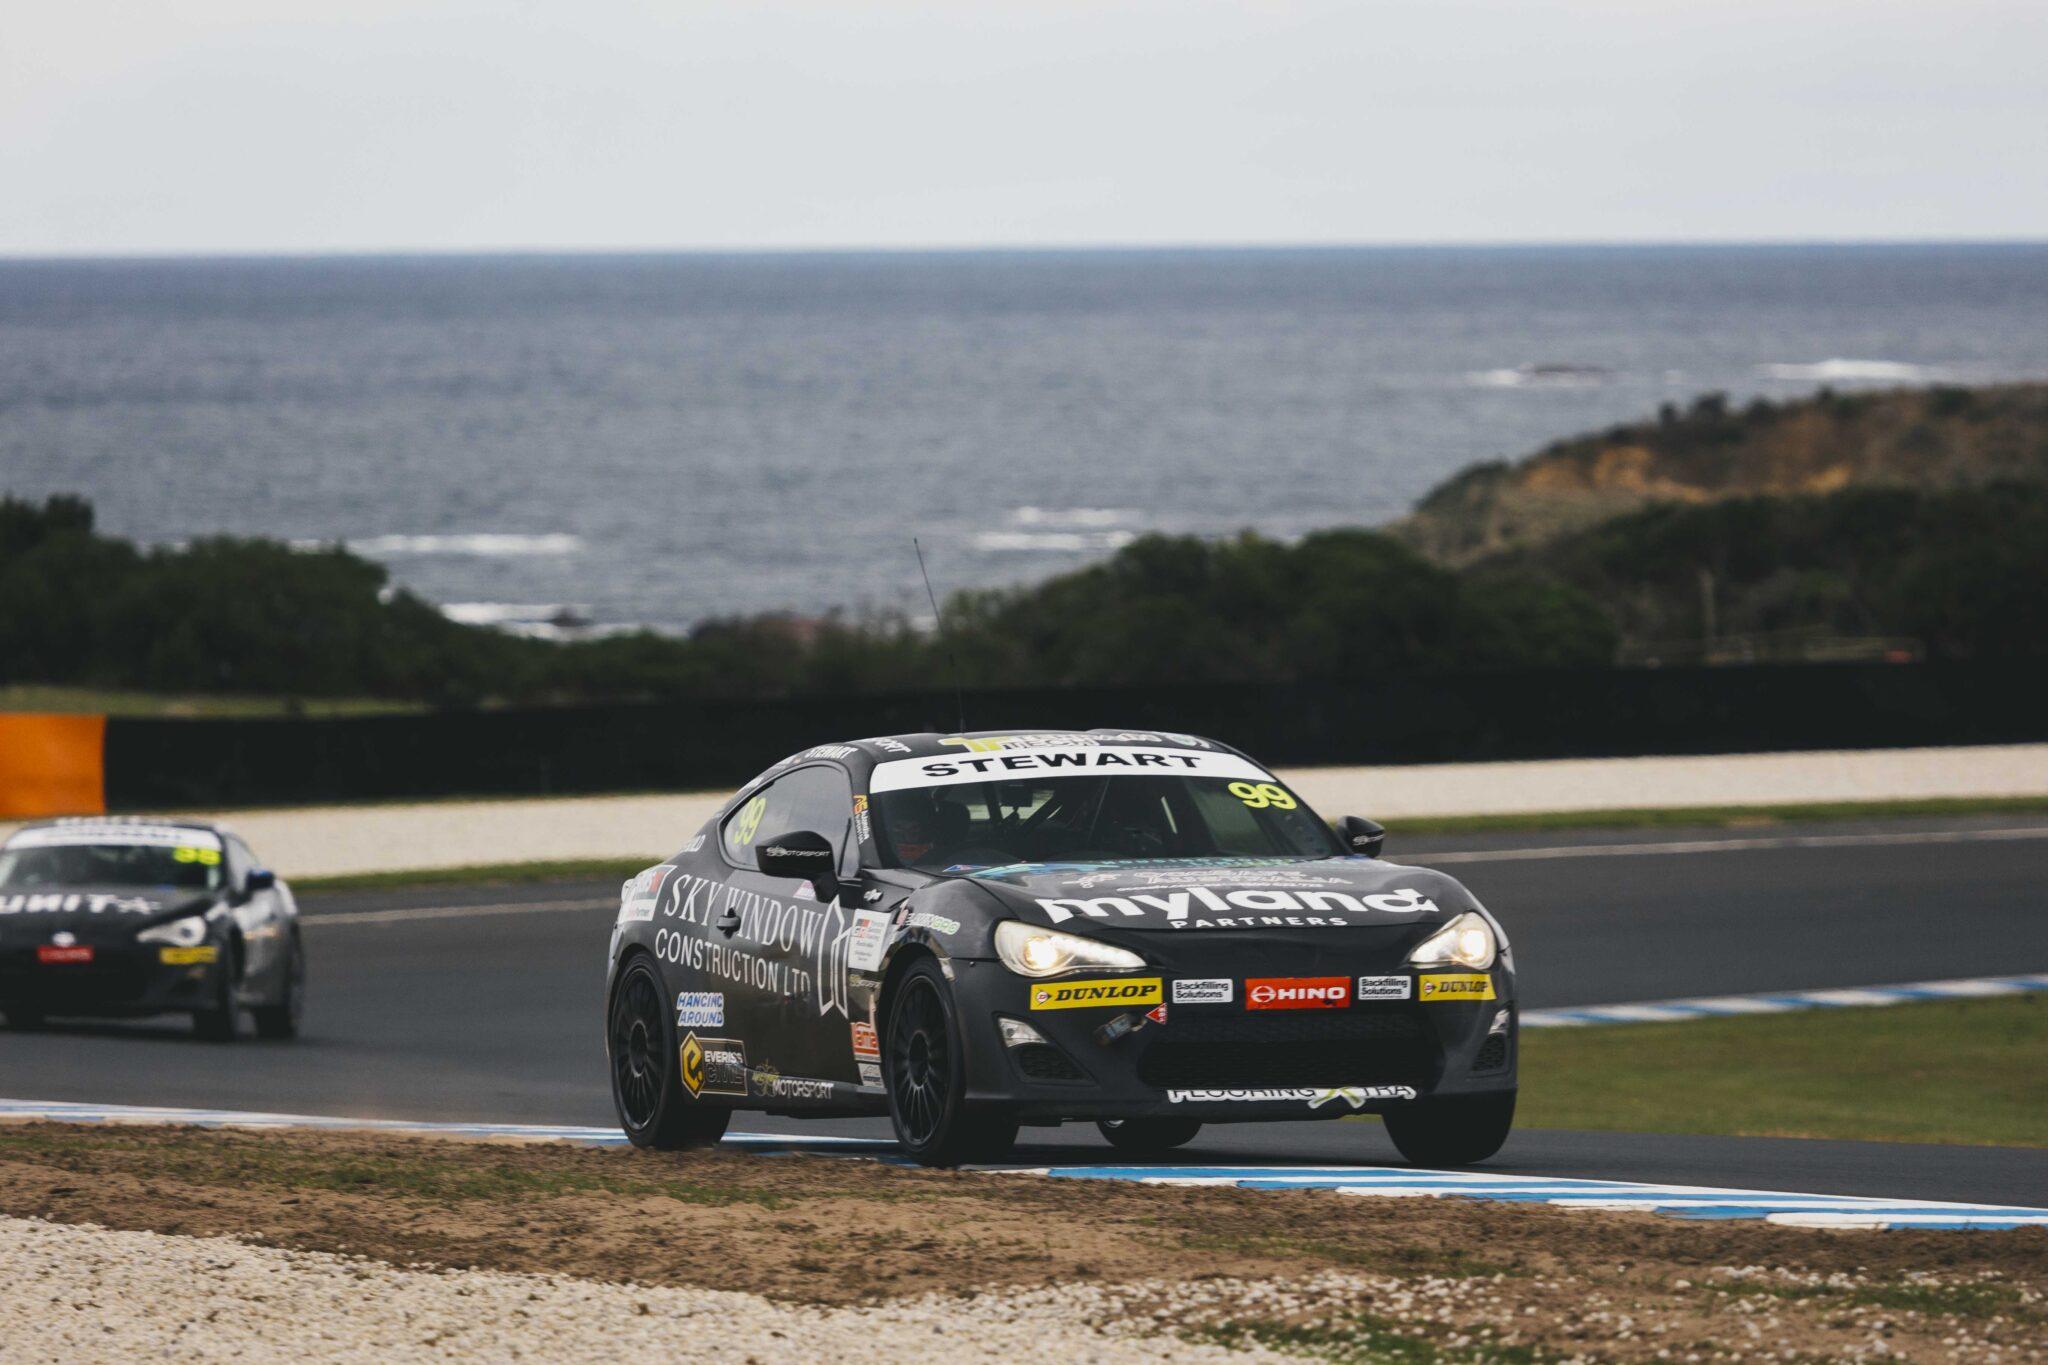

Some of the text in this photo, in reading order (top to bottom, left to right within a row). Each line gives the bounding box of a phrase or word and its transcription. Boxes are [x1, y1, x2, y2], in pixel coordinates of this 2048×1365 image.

[922, 753, 1201, 777] STEWART
[1228, 781, 1298, 810] 99
[1034, 887, 1440, 924] myland
[664, 873, 724, 927] SKY
[724, 885, 825, 959] WINDOW
[1170, 917, 1349, 929] PARTNERS
[655, 928, 779, 993] CONSTRUCTION
[1175, 981, 1229, 992] Backfilling
[1361, 978, 1408, 989] Backfilling
[1438, 980, 1489, 994] DUNLOP
[1055, 985, 1159, 1002] DUNLOP
[1175, 990, 1224, 999] Solutions
[1277, 986, 1346, 1000] HINO
[1361, 987, 1403, 997] Solutions
[678, 1009, 724, 1025] AROUND
[772, 1078, 834, 1099] MOTORSPORT
